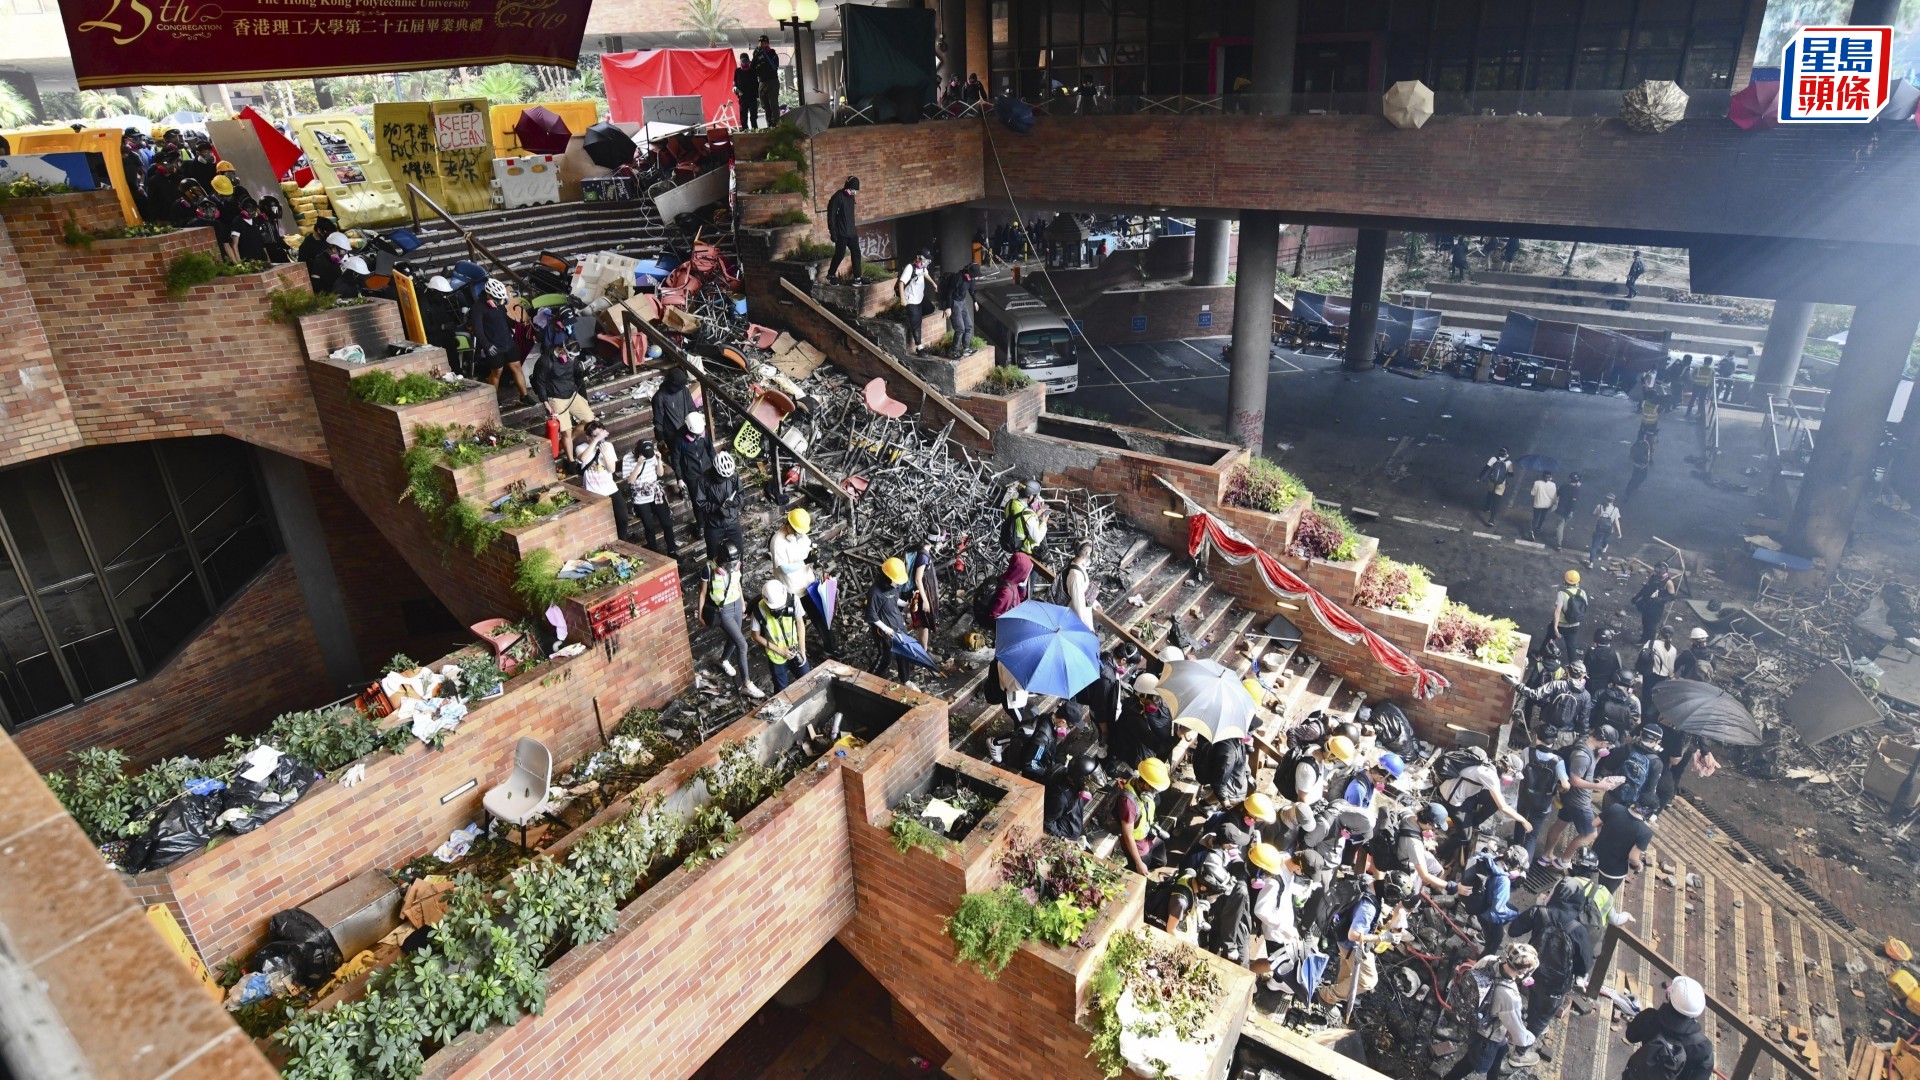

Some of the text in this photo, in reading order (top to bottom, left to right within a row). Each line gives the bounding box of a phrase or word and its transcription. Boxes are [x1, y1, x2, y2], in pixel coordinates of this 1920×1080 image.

[356, 0, 417, 9] Polytechnic
[420, 0, 471, 9] University
[156, 23, 222, 31] CONGREGATION
[233, 18, 484, 36] 香港理工大學第二十五屆畢業典禮
[439, 113, 480, 131] KEEP
[439, 129, 485, 149] CLEAN
